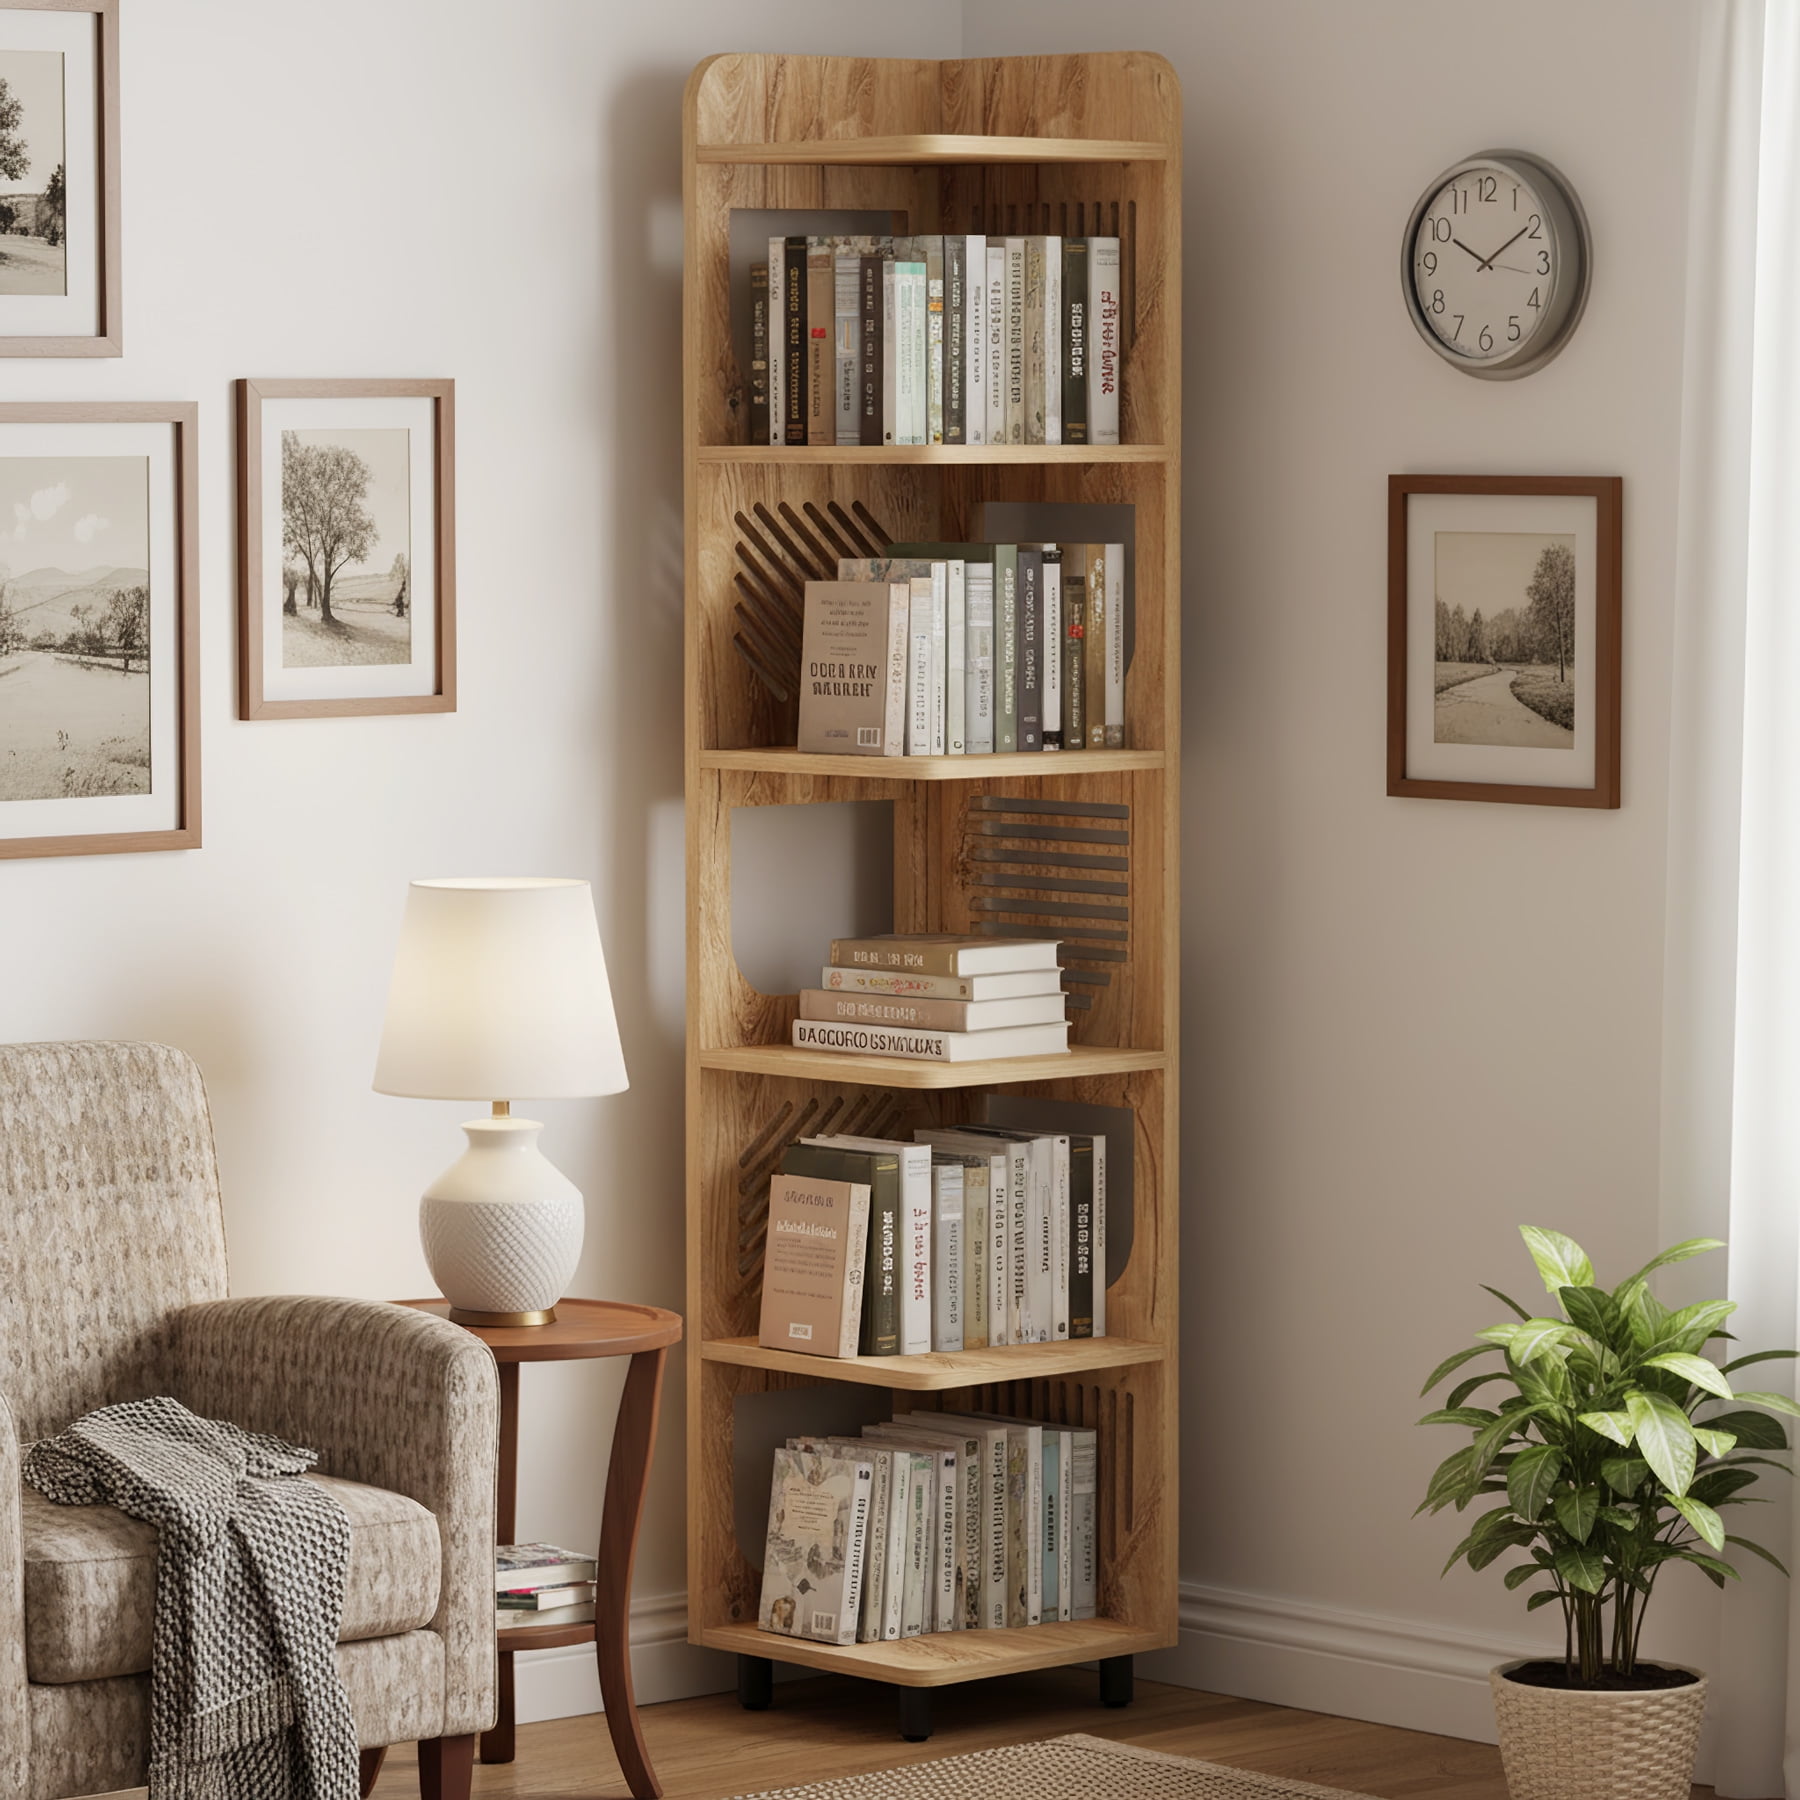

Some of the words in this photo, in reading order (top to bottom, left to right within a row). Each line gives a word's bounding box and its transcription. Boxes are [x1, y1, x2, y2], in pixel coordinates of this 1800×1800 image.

[1452, 187, 1467, 214] 11
[1477, 176, 1497, 202] 12
[1512, 187, 1518, 212] 1
[1428, 216, 1451, 242] 10
[1528, 214, 1542, 239] 2
[1423, 252, 1437, 276] 9
[1537, 250, 1550, 275] 3
[1432, 289, 1445, 314] 8
[1526, 287, 1541, 313] 4
[1453, 315, 1464, 341] 7
[1478, 324, 1493, 351] 6
[1507, 315, 1521, 341] 5
